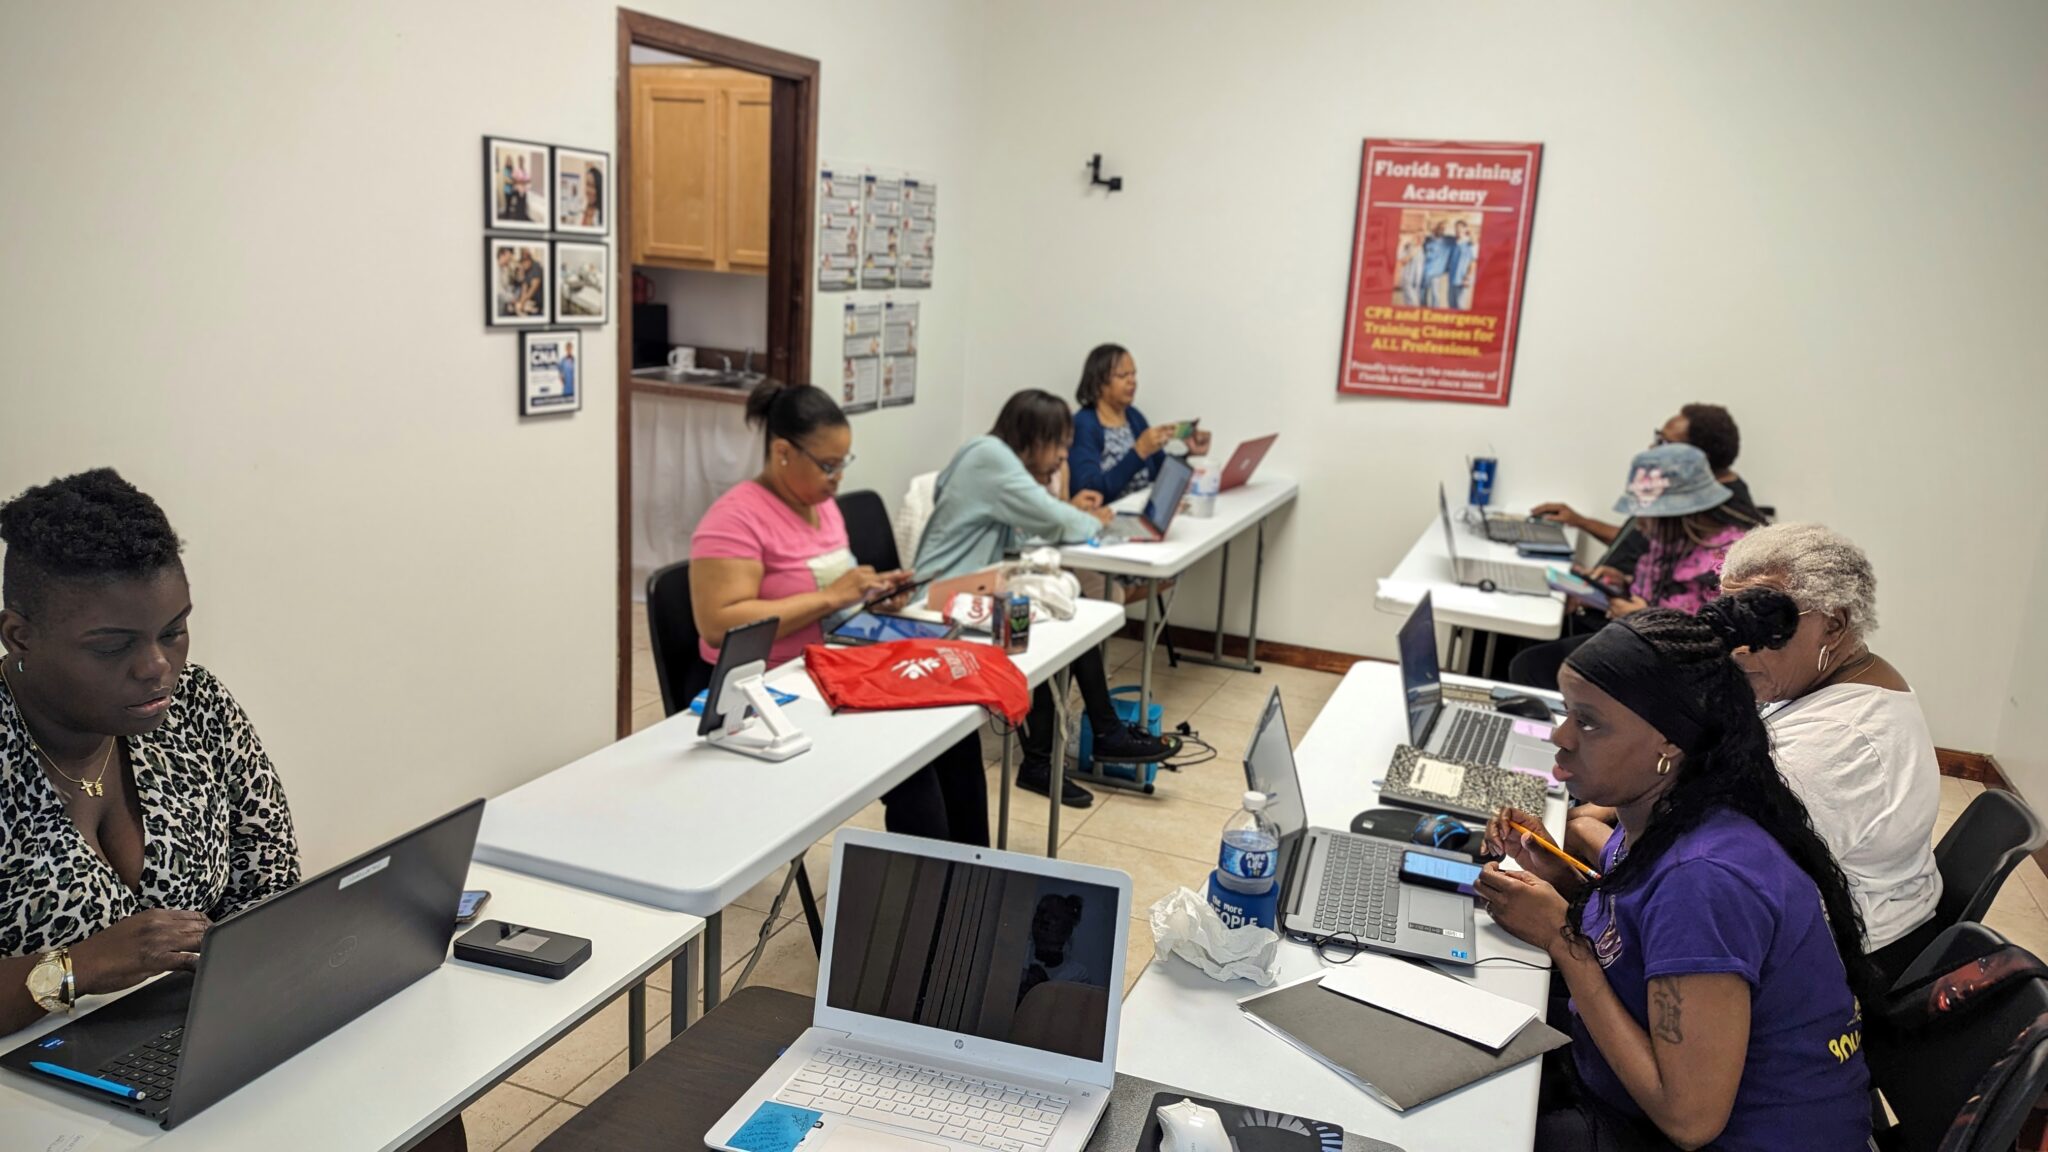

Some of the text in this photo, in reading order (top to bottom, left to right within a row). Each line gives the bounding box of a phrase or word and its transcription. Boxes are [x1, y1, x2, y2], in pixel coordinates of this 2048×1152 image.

[1374, 160, 1524, 185] Florida Training
[1403, 184, 1488, 206] Academy
[1365, 306, 1498, 329] CPR and Emergency
[1363, 321, 1496, 342] Training Classes for
[1372, 337, 1399, 351] ALL
[1387, 363, 1424, 376] training
[1425, 366, 1440, 377] the
[1245, 852, 1266, 861] Pure
[1246, 860, 1264, 870] Life
[1212, 895, 1243, 914] the more
[1210, 904, 1258, 928] OPLE
